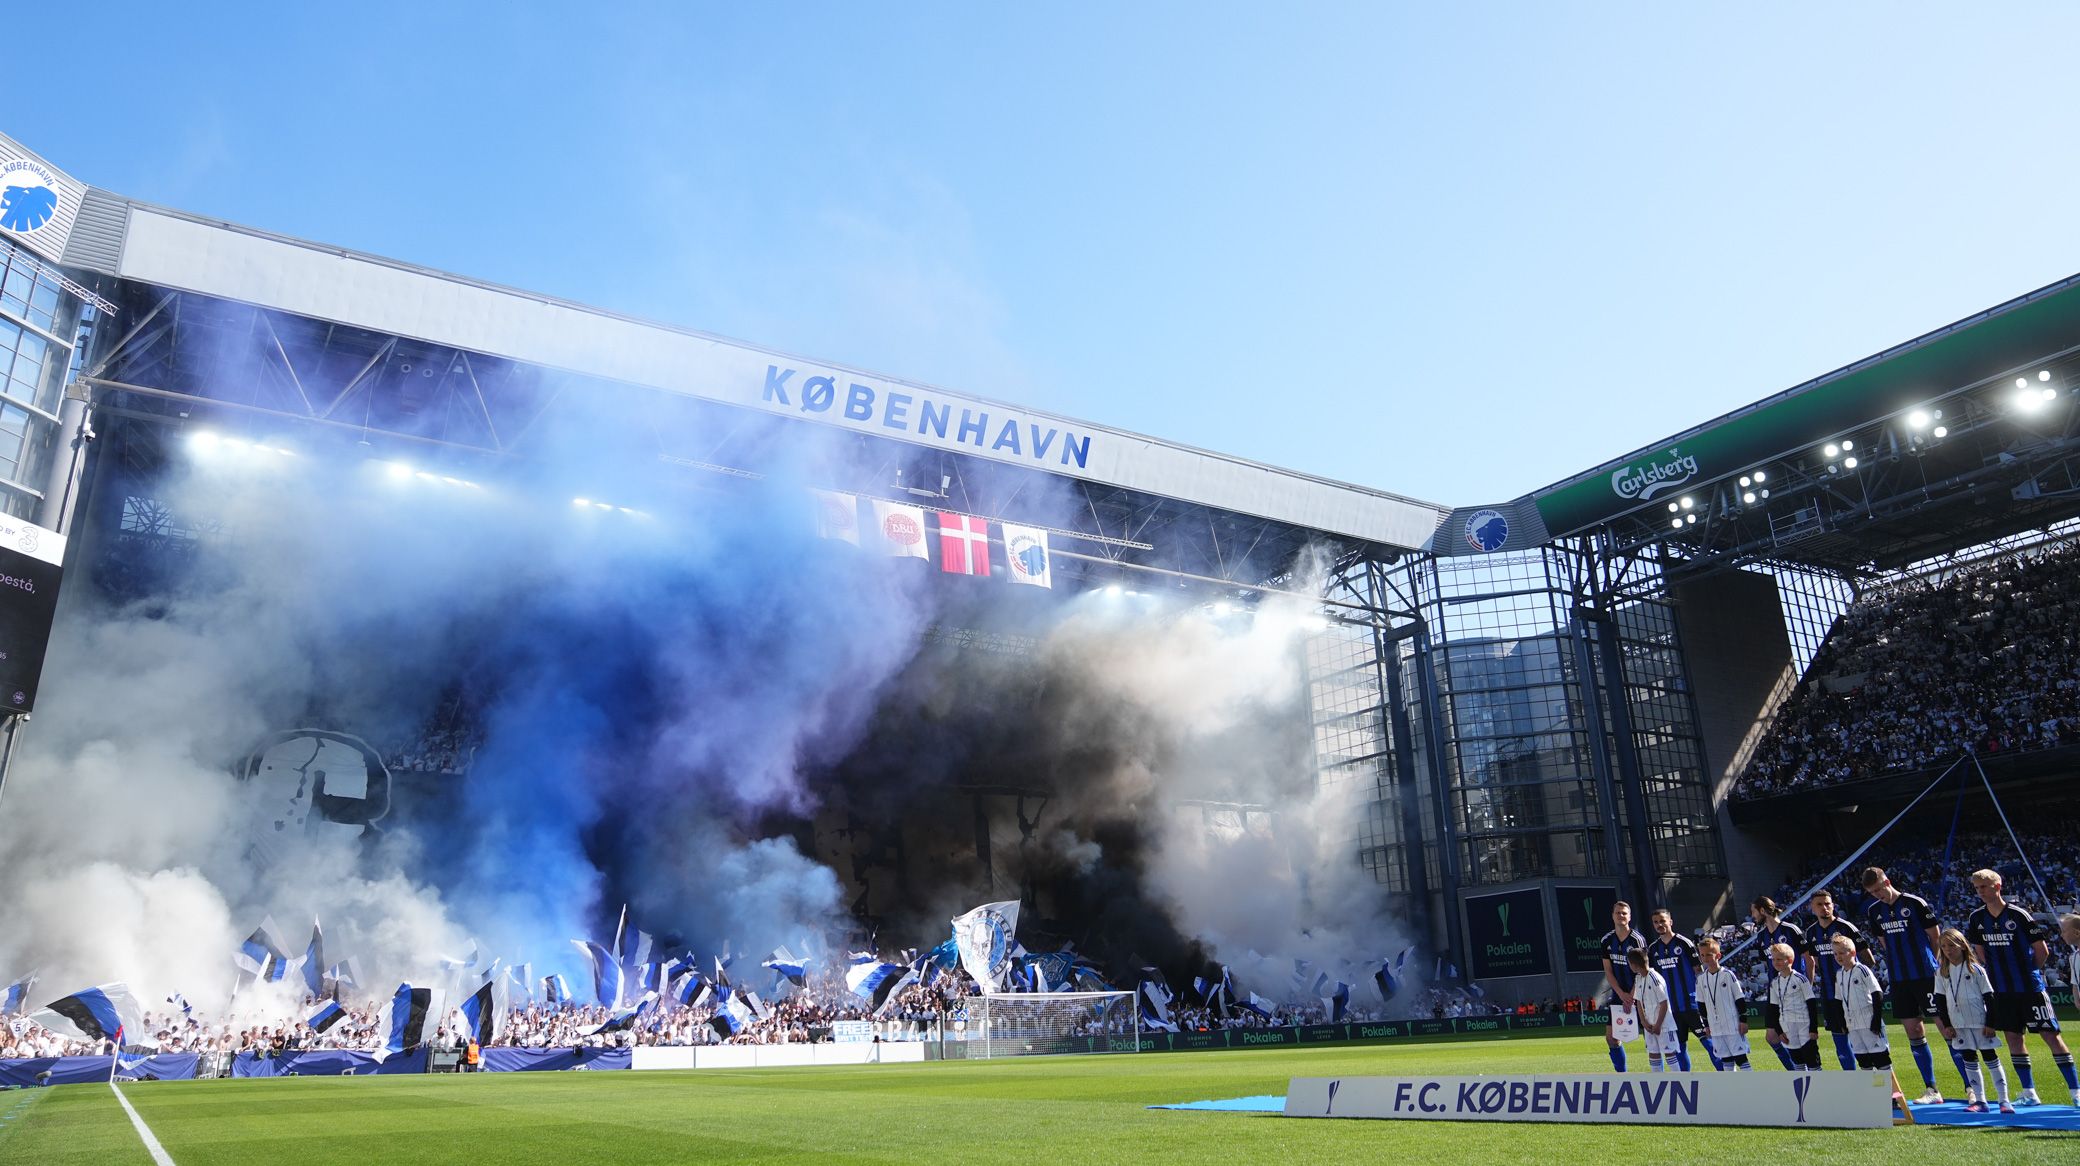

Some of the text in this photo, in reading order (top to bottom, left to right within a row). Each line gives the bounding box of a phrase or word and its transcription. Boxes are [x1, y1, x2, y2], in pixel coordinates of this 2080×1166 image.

[3, 161, 54, 187] KØBENHAVN
[762, 365, 1092, 469] KØBENHAVN
[1611, 454, 1699, 500] Carlsberg
[1880, 920, 1908, 930] UNIBET
[1982, 933, 2014, 941] UNIBET
[1486, 942, 1532, 956] Pokalen
[1657, 956, 1678, 966] UNIBET
[2032, 1006, 2049, 1021] 30
[836, 1023, 870, 1035] FREE
[1361, 1025, 1397, 1038] Pokalen
[1466, 1020, 1498, 1031] Pokalen
[1244, 1032, 1284, 1043] Pokalen
[1110, 1039, 1154, 1051] Pokaen
[1394, 1080, 1699, 1115] F.C. KØBENHAVN
